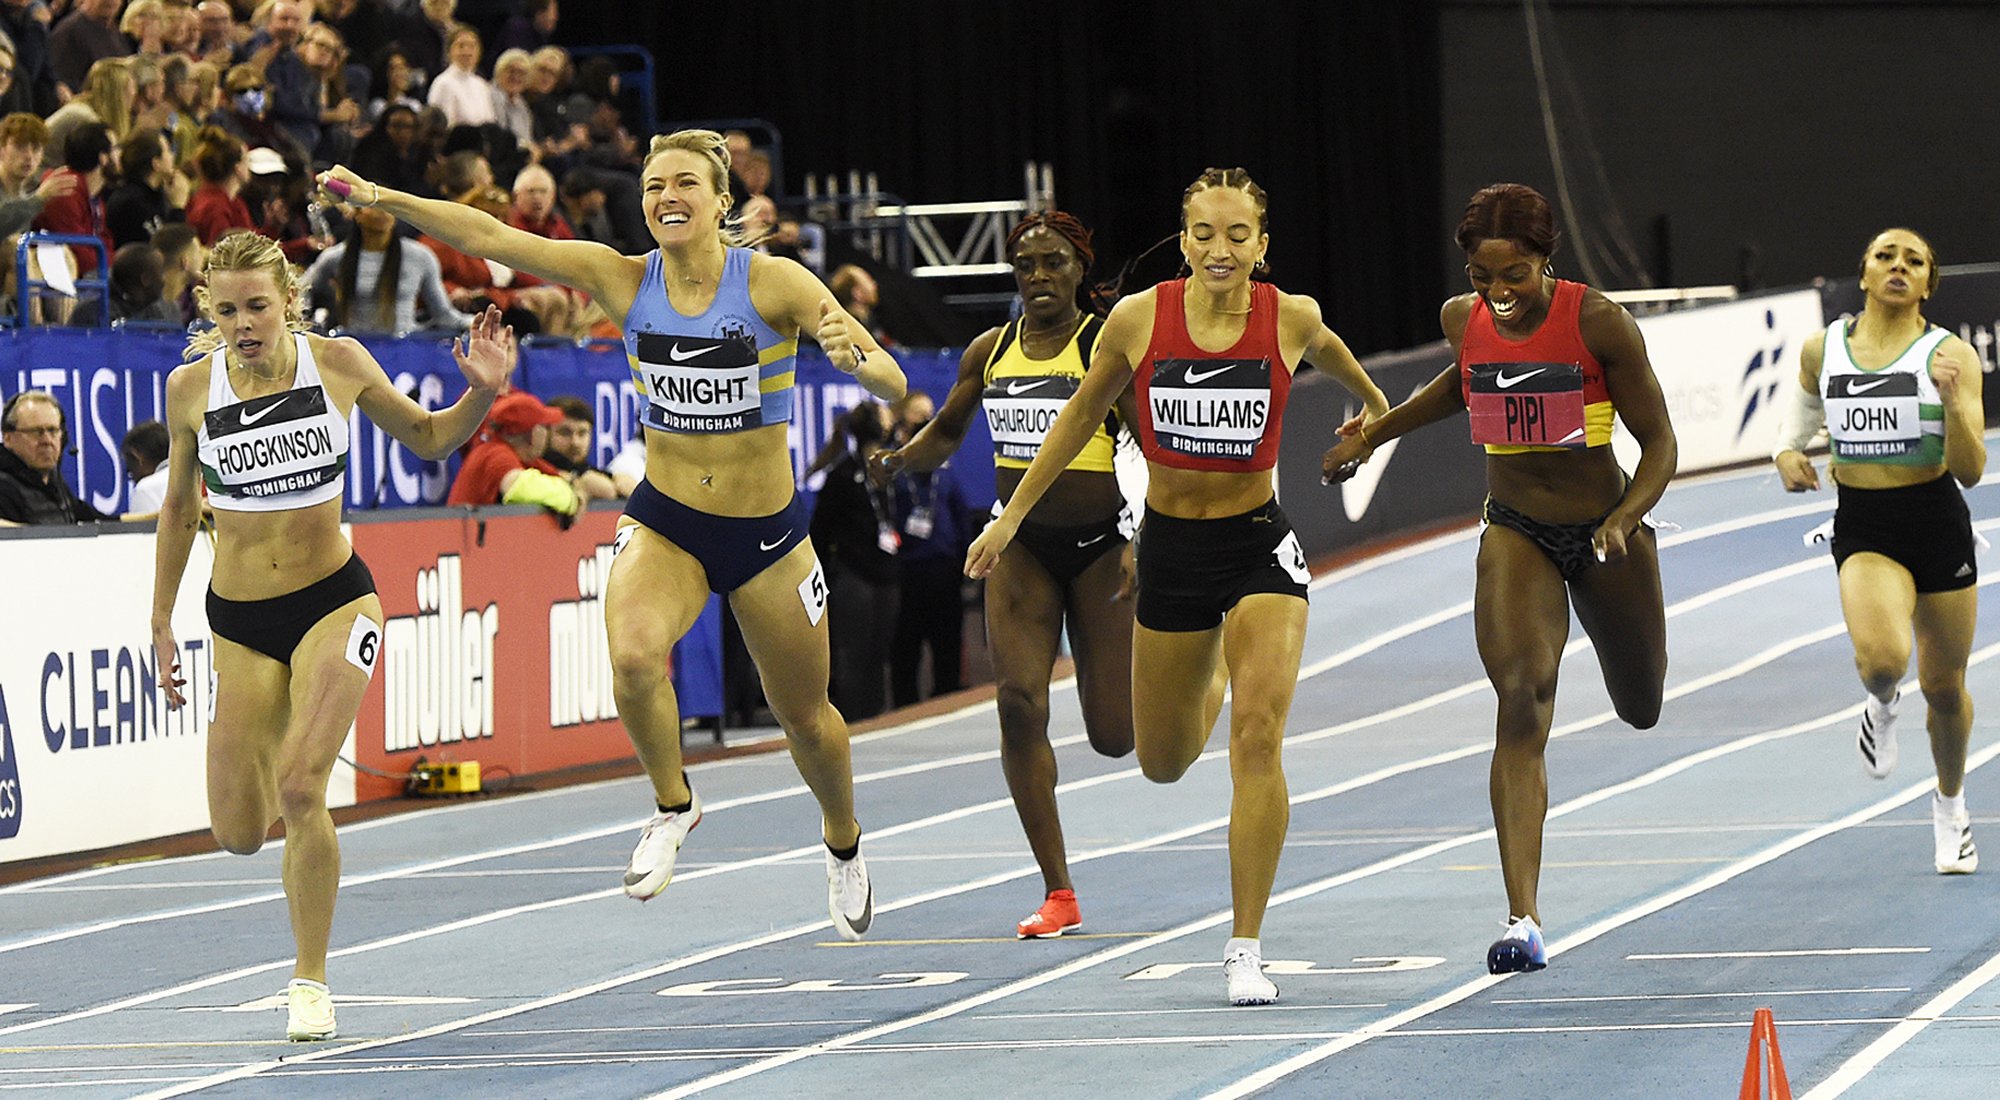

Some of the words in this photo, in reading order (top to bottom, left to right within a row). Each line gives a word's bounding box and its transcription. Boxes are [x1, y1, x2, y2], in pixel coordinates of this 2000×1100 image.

[650, 373, 749, 405] KNIGHT
[663, 411, 743, 430] BIRMINGHAM
[1153, 398, 1266, 429] WILLIAMS
[1504, 396, 1547, 442] PIPI
[1841, 407, 1898, 432] JOHN
[217, 425, 333, 476] HODGKINSON
[1172, 436, 1252, 456] BIRMINGHAM
[242, 471, 322, 497] BIRMINGHAM
[811, 571, 824, 608] 5
[358, 631, 378, 666] 6
[383, 552, 499, 754] müller
